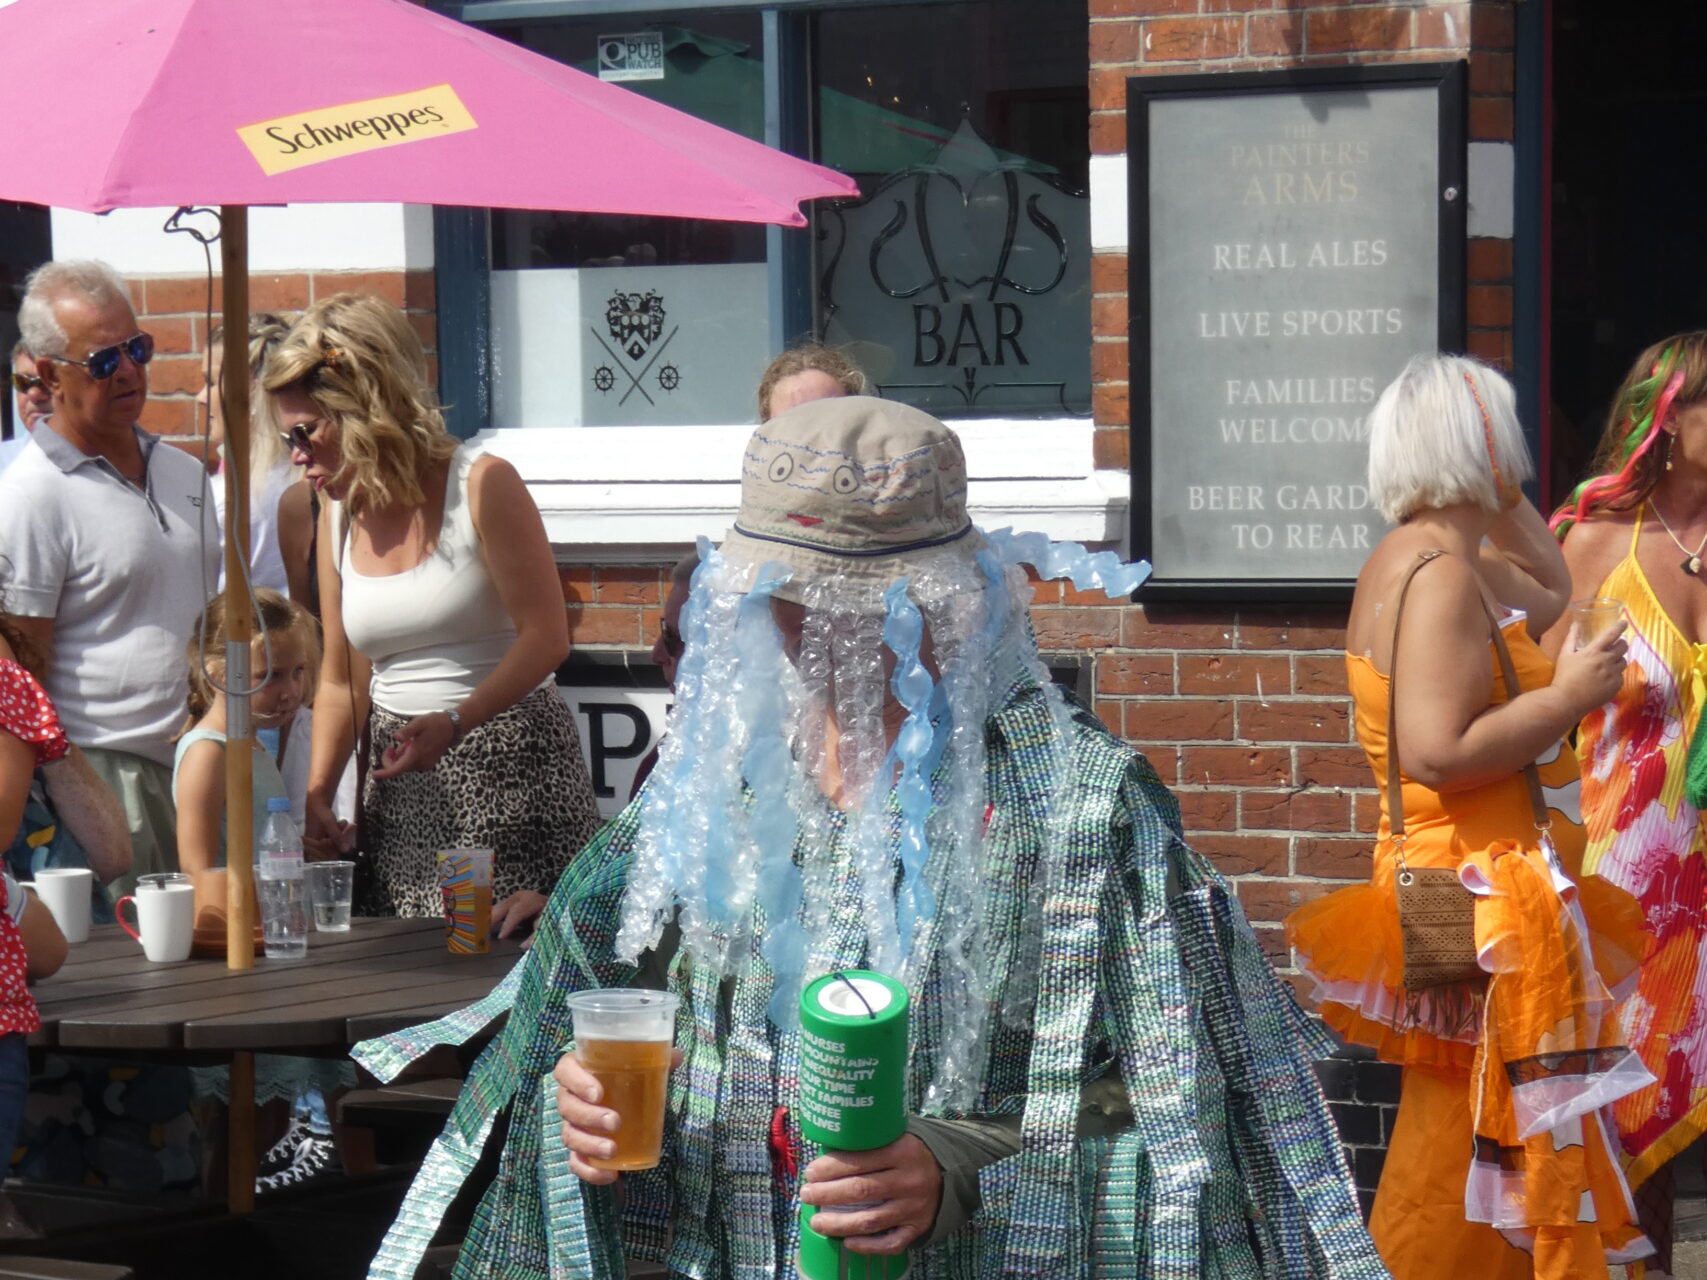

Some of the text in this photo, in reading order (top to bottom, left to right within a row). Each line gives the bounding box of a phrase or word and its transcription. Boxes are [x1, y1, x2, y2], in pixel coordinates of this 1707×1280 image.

[627, 42, 662, 59] PUB
[627, 59, 662, 70] WATCH
[265, 105, 445, 155] Schweppes
[1283, 123, 1319, 139] THE
[1230, 140, 1370, 169] PAINTERS
[1242, 170, 1360, 206] ARMS
[1212, 240, 1389, 270] REAL ALES
[912, 301, 1030, 367] BAR
[1199, 308, 1403, 339] LIVE SPORTS
[1225, 376, 1377, 406] FAMILIES
[1218, 417, 1365, 444] WELCOM
[1187, 484, 1380, 511] BEER GARD
[1231, 523, 1372, 550] TO REAR
[804, 1029, 846, 1054] NURSES
[817, 1091, 875, 1108] FAMILIES
[822, 1079, 856, 1094] TIME
[805, 1097, 842, 1119] COFFEE
[812, 1115, 841, 1133] LIVES
